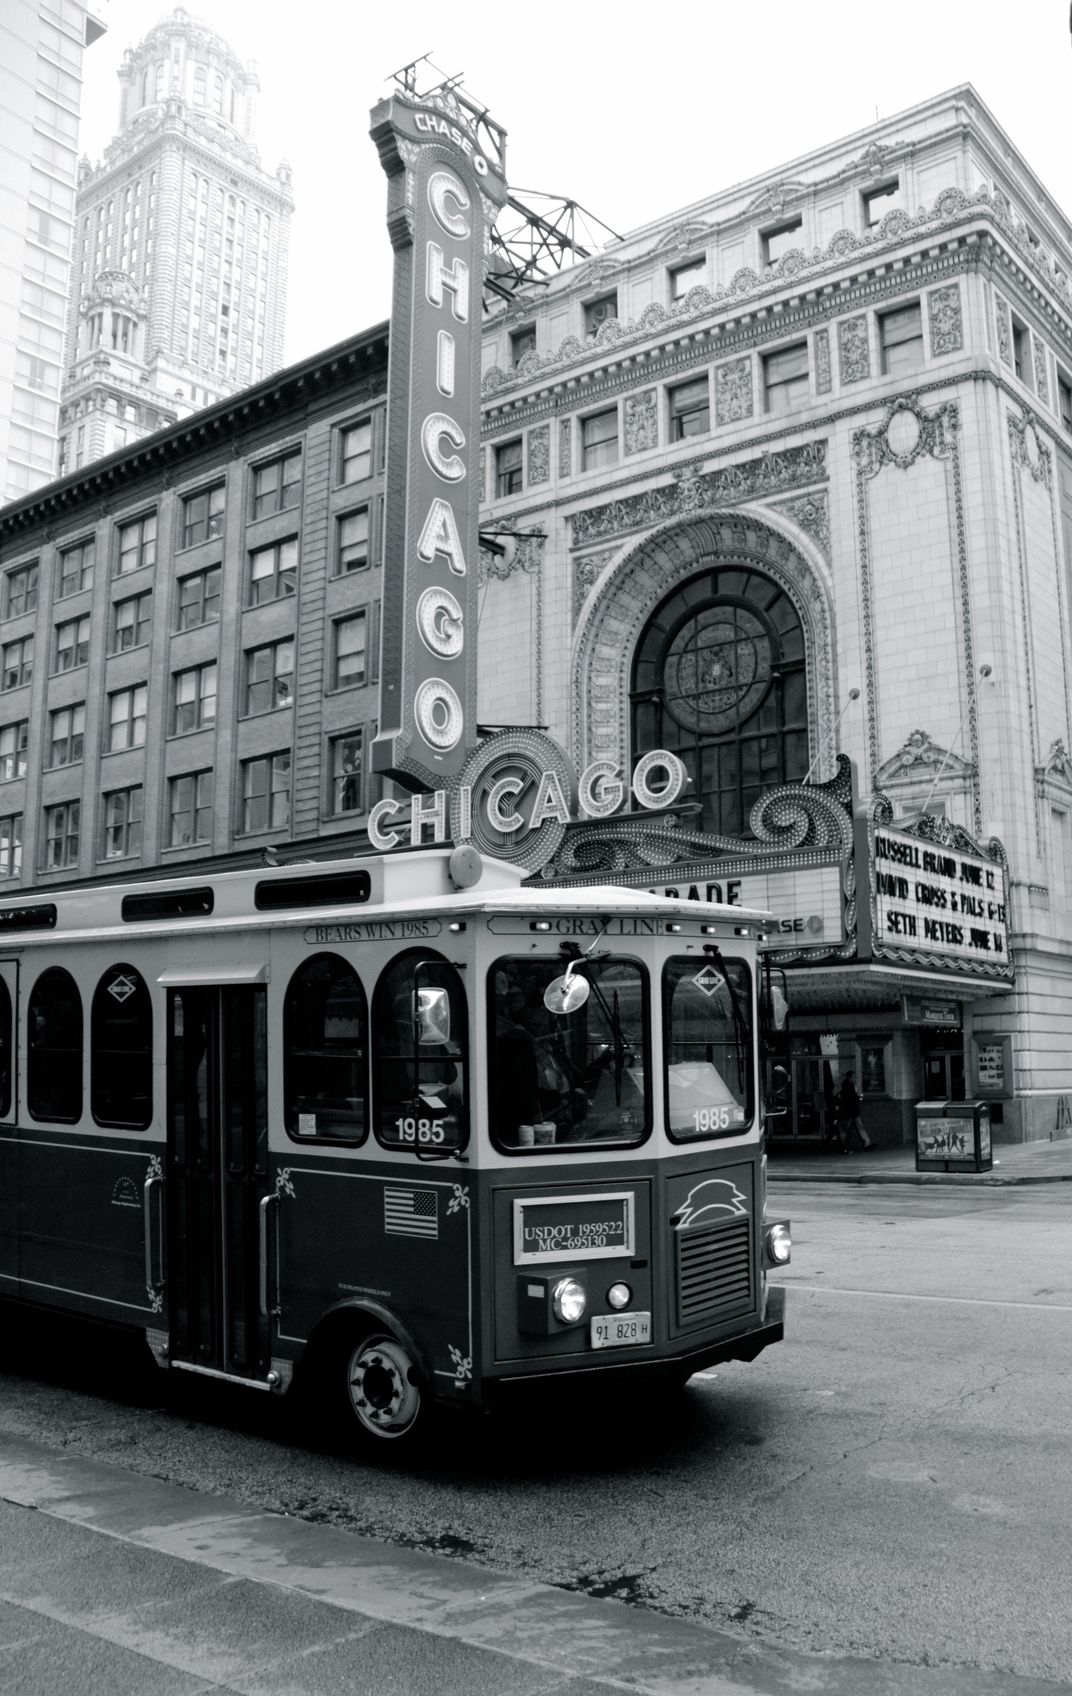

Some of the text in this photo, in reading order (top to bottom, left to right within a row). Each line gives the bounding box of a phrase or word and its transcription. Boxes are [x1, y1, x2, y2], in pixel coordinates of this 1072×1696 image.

[414, 113, 474, 156] CHASE
[414, 171, 471, 752] CHICAGO
[367, 750, 686, 850] CHICAGO
[876, 835, 921, 869] RUSSELL
[923, 850, 956, 879] BRAND
[959, 862, 983, 887] JUNE
[876, 871, 909, 900] DAVID
[915, 881, 948, 909] CROSS
[960, 893, 984, 918] PALS
[315, 920, 430, 942] BEARS WIN 1985
[619, 919, 664, 935] LINE
[887, 910, 917, 936] SETH
[924, 917, 964, 945] MEYERS
[968, 927, 991, 951] JUNE
[395, 1118, 445, 1143] 1985
[693, 1107, 729, 1132] 1985
[525, 1221, 624, 1240] USDOT 1959522
[538, 1235, 607, 1251] MC-695130
[596, 1322, 648, 1340] 91 828 H
